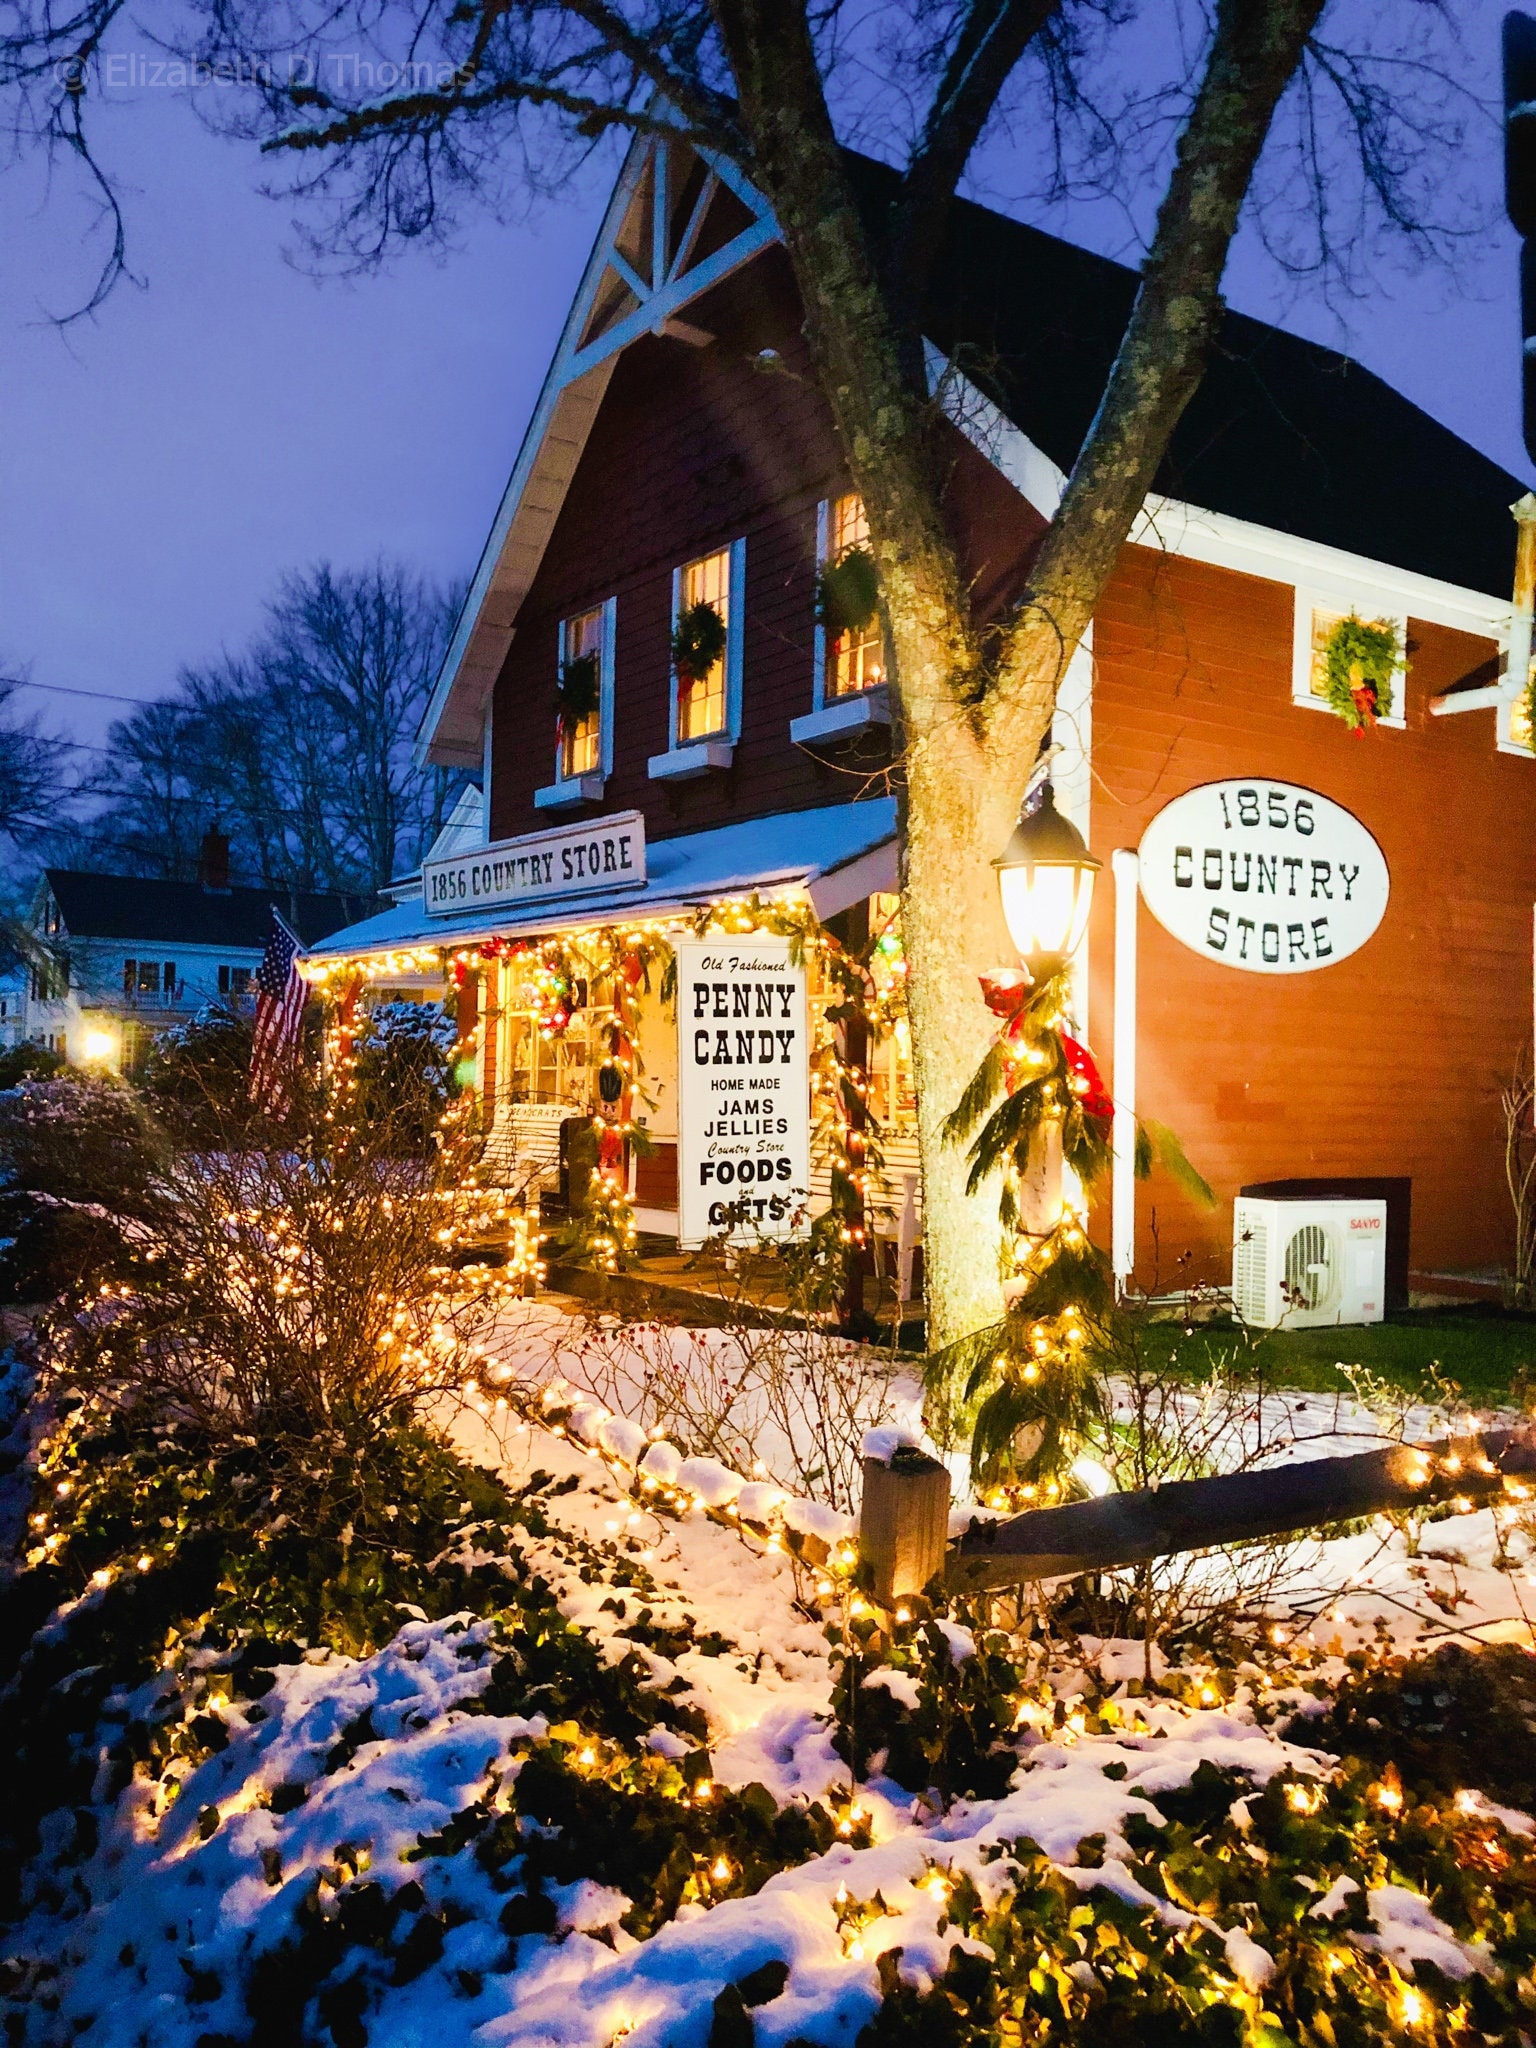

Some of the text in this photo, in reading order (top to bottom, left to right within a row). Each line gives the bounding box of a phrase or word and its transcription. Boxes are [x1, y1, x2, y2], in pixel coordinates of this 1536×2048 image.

[1220, 788, 1315, 836] 1856
[431, 836, 632, 902] 1856 COUNTRY STORE
[1174, 845, 1360, 901] COUNTRY
[1206, 906, 1333, 963] STORE
[701, 956, 787, 973] Old Fashioned
[693, 983, 796, 1018] PENNY
[694, 1029, 795, 1066] CANDY
[711, 1078, 781, 1091] HOME MADE
[718, 1099, 774, 1116] JAMS
[704, 1118, 788, 1137] JELLIES
[707, 1139, 785, 1158] Country Store
[700, 1157, 792, 1186] FOODS
[1350, 1218, 1381, 1230] SANYO
